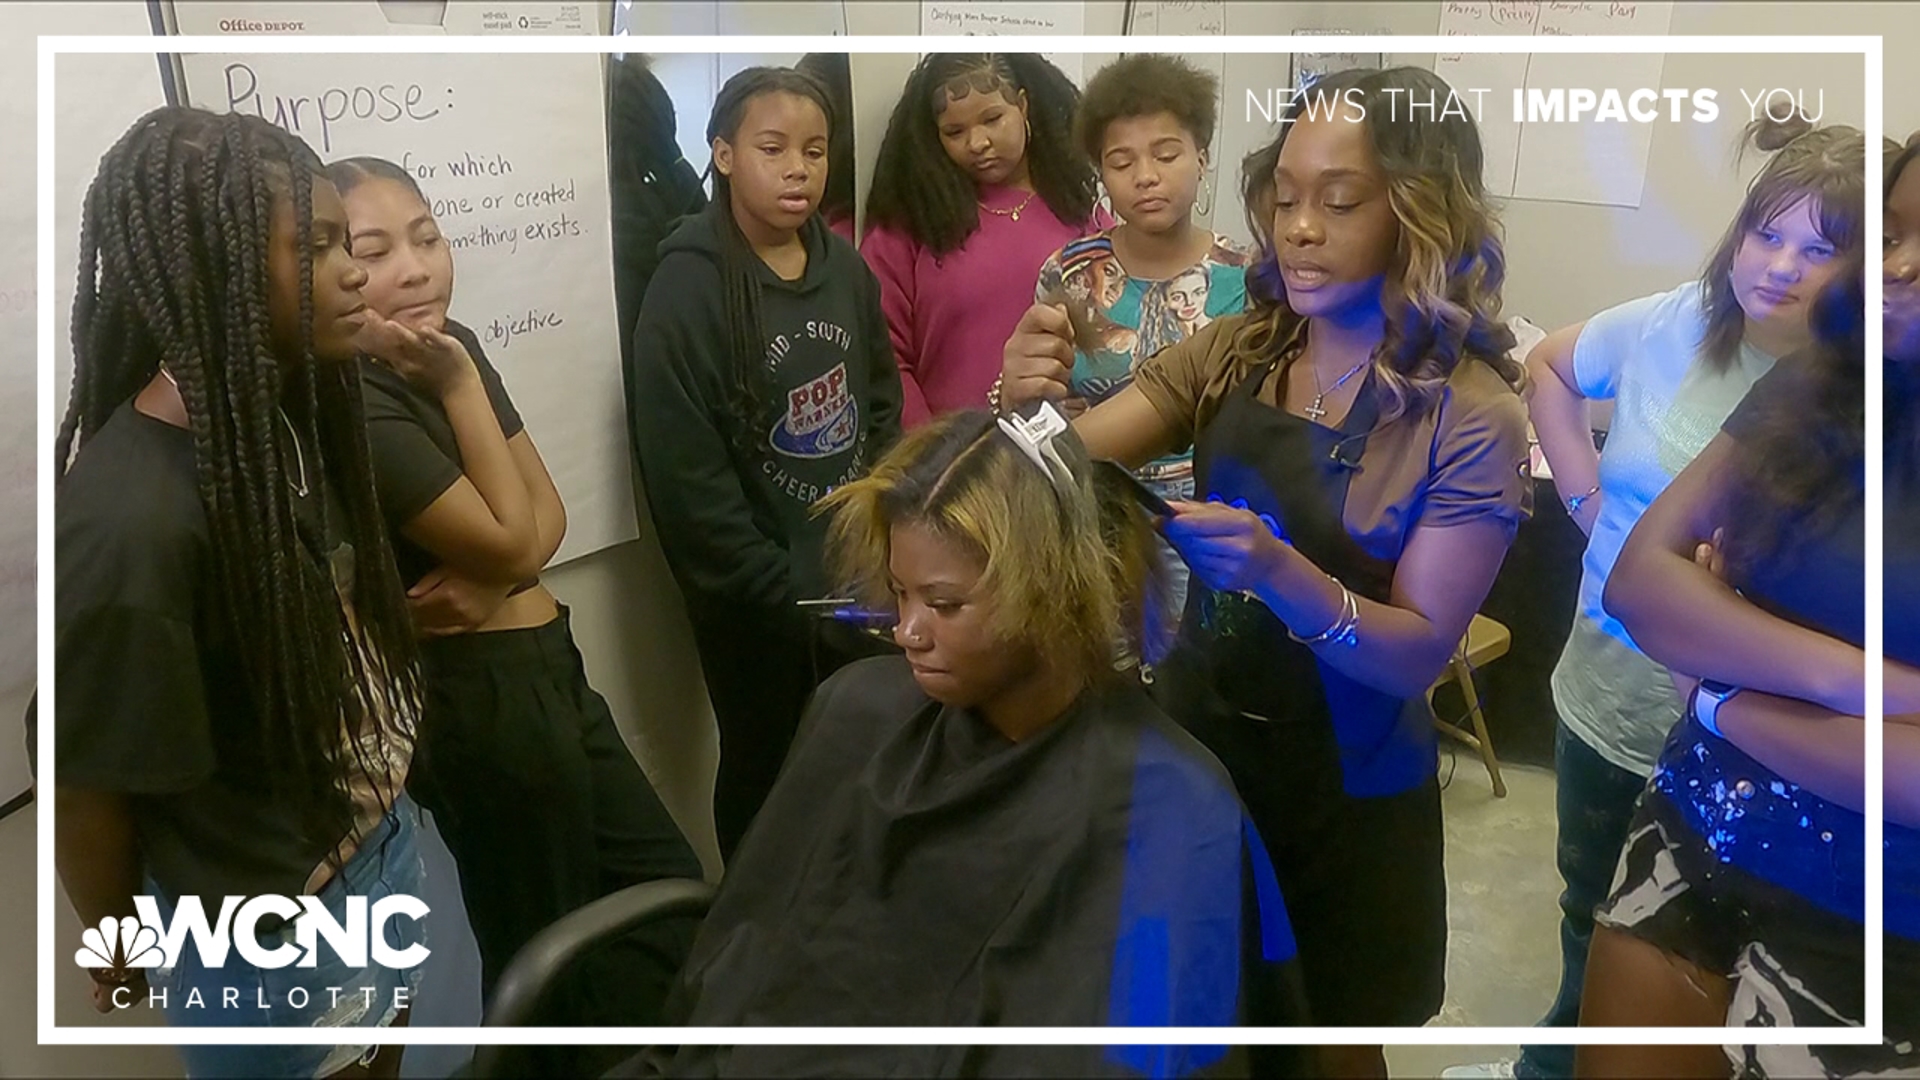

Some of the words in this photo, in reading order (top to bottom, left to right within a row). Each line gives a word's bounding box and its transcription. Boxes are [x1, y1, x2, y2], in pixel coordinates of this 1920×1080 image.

[219, 19, 262, 32] Office
[264, 21, 304, 32] DEPOT
[224, 63, 454, 153] Purpose:
[447, 152, 514, 178] which
[482, 195, 505, 211] or
[514, 178, 576, 208] created
[484, 309, 564, 348] objective
[806, 320, 851, 351] SOUTH
[791, 367, 844, 418] POP
[762, 460, 819, 503] CHEER
